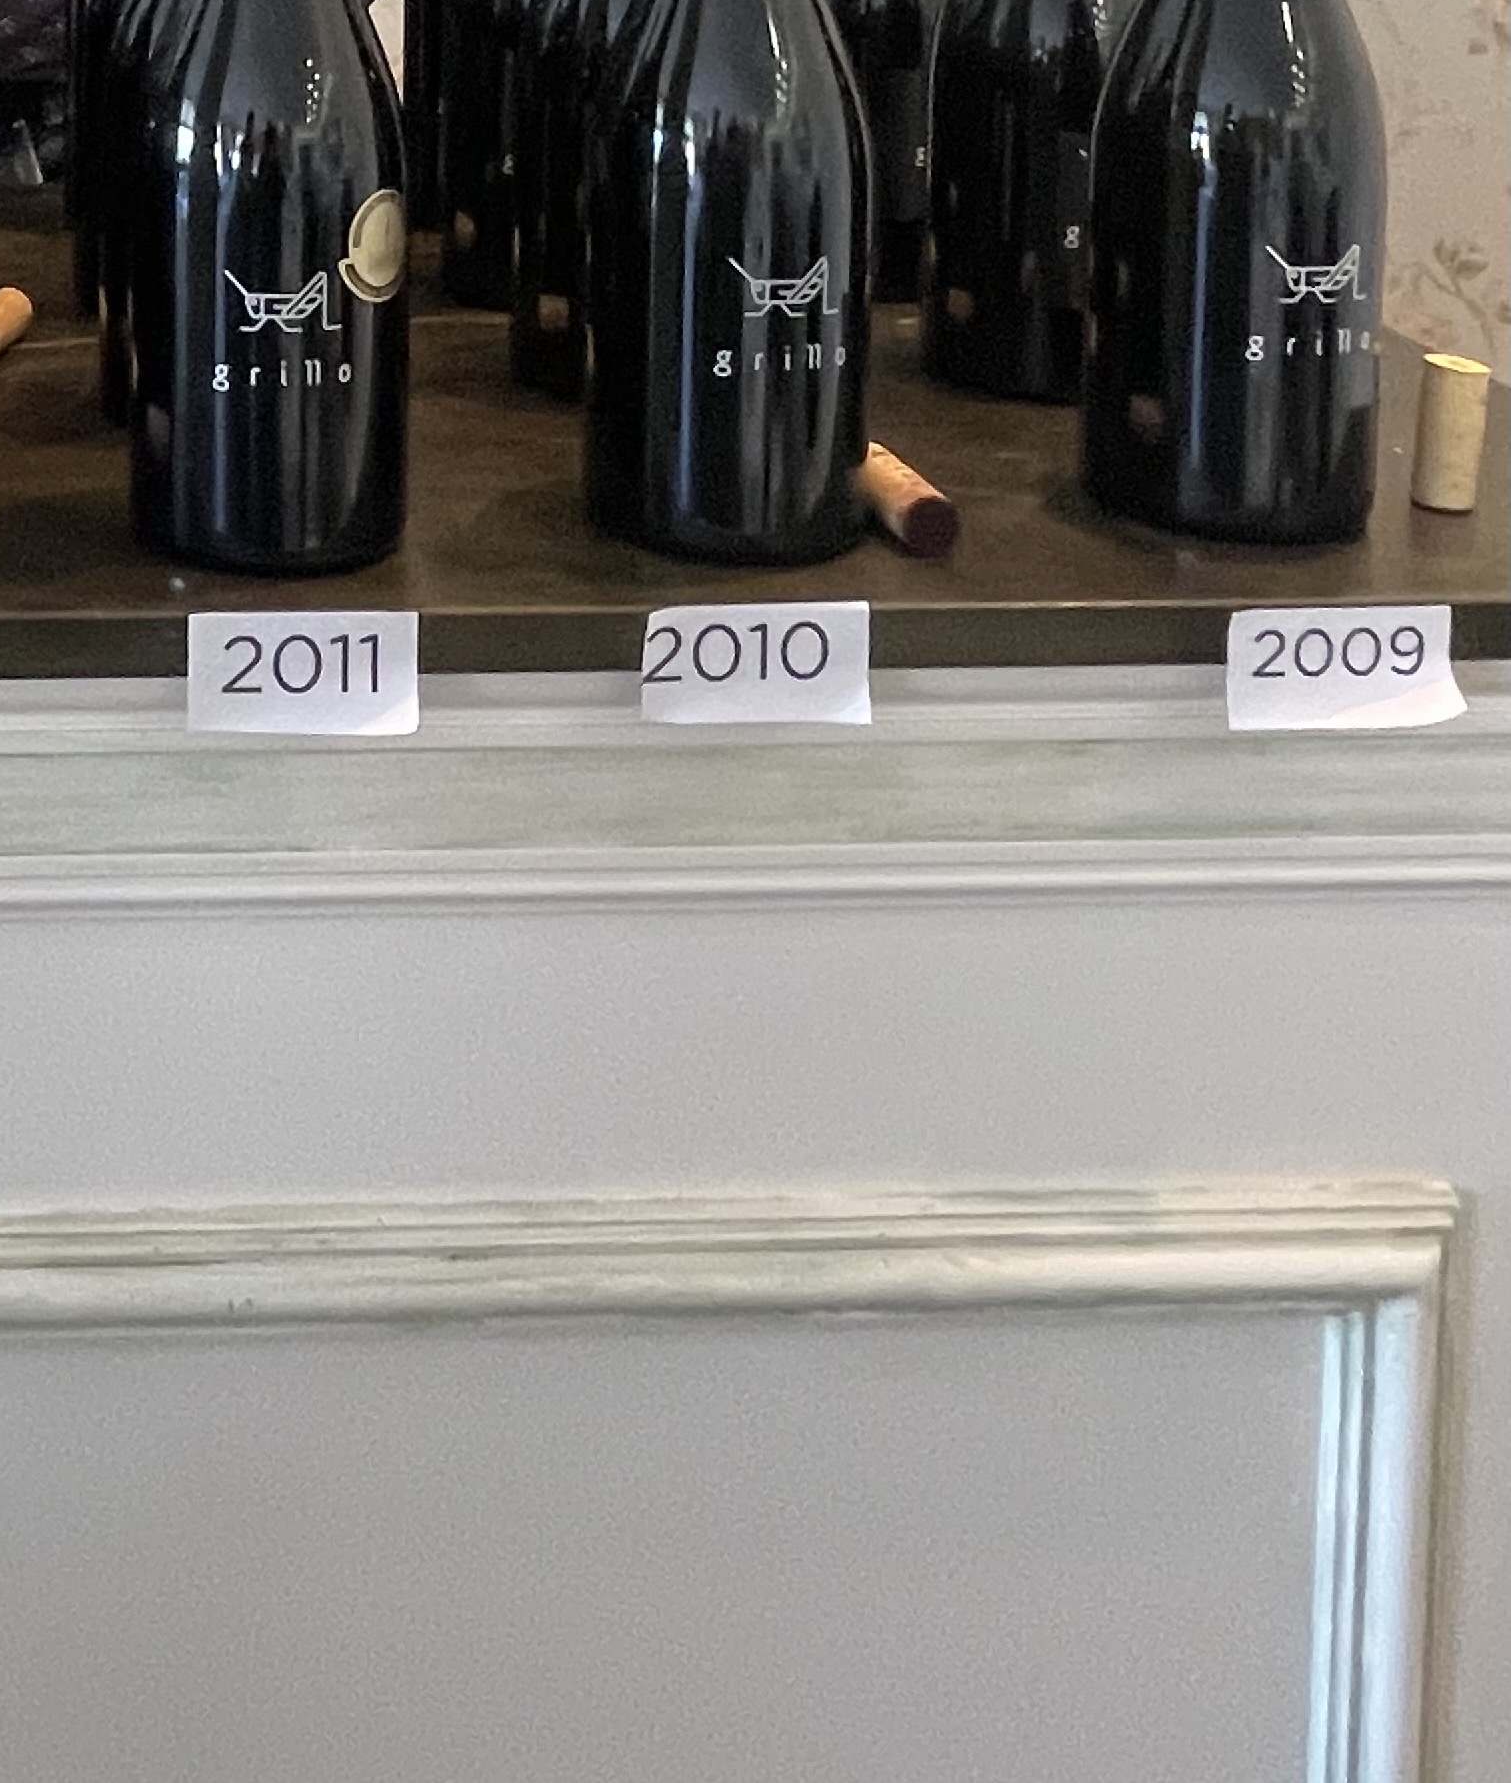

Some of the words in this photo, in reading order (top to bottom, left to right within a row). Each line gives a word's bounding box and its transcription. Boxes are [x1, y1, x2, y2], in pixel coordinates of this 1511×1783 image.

[220, 632, 382, 695] 2011
[641, 620, 830, 686] 2010
[1250, 624, 1426, 680] 2009
